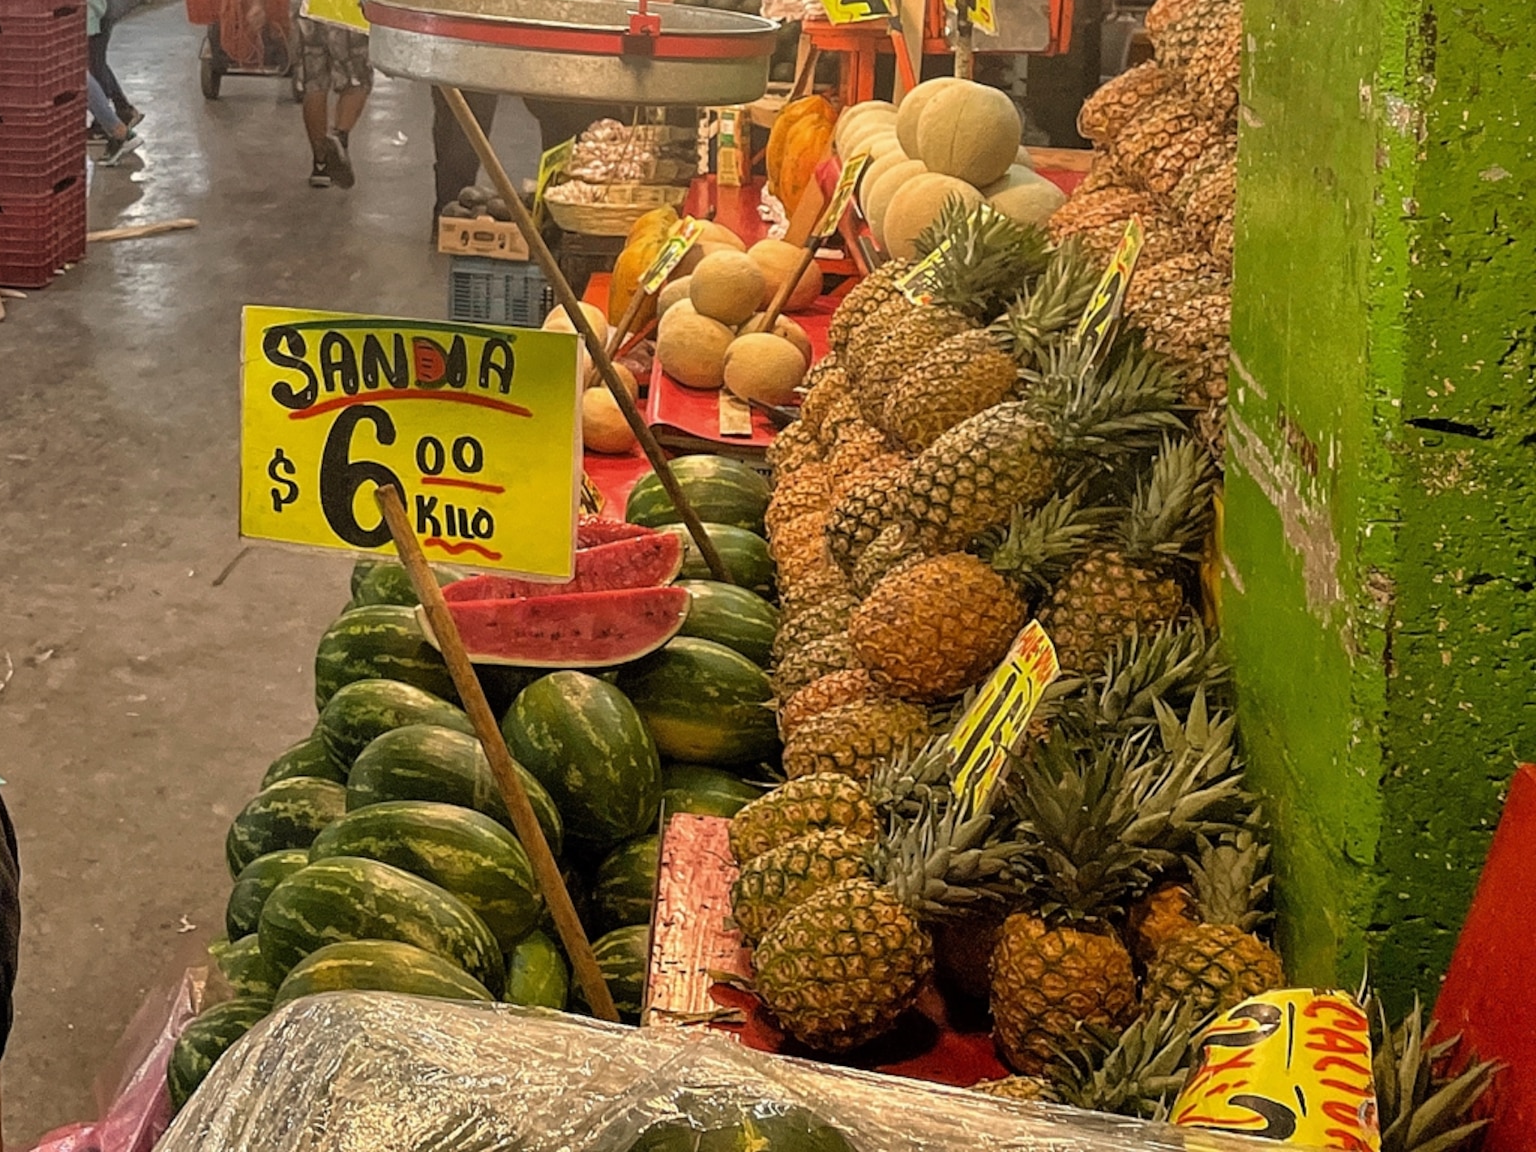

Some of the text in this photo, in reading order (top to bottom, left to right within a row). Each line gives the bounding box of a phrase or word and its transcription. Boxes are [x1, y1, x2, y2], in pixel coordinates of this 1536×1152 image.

[263, 326, 514, 410] SANDIA
[268, 404, 484, 548] $ 6 00
[416, 495, 494, 539] KILO
